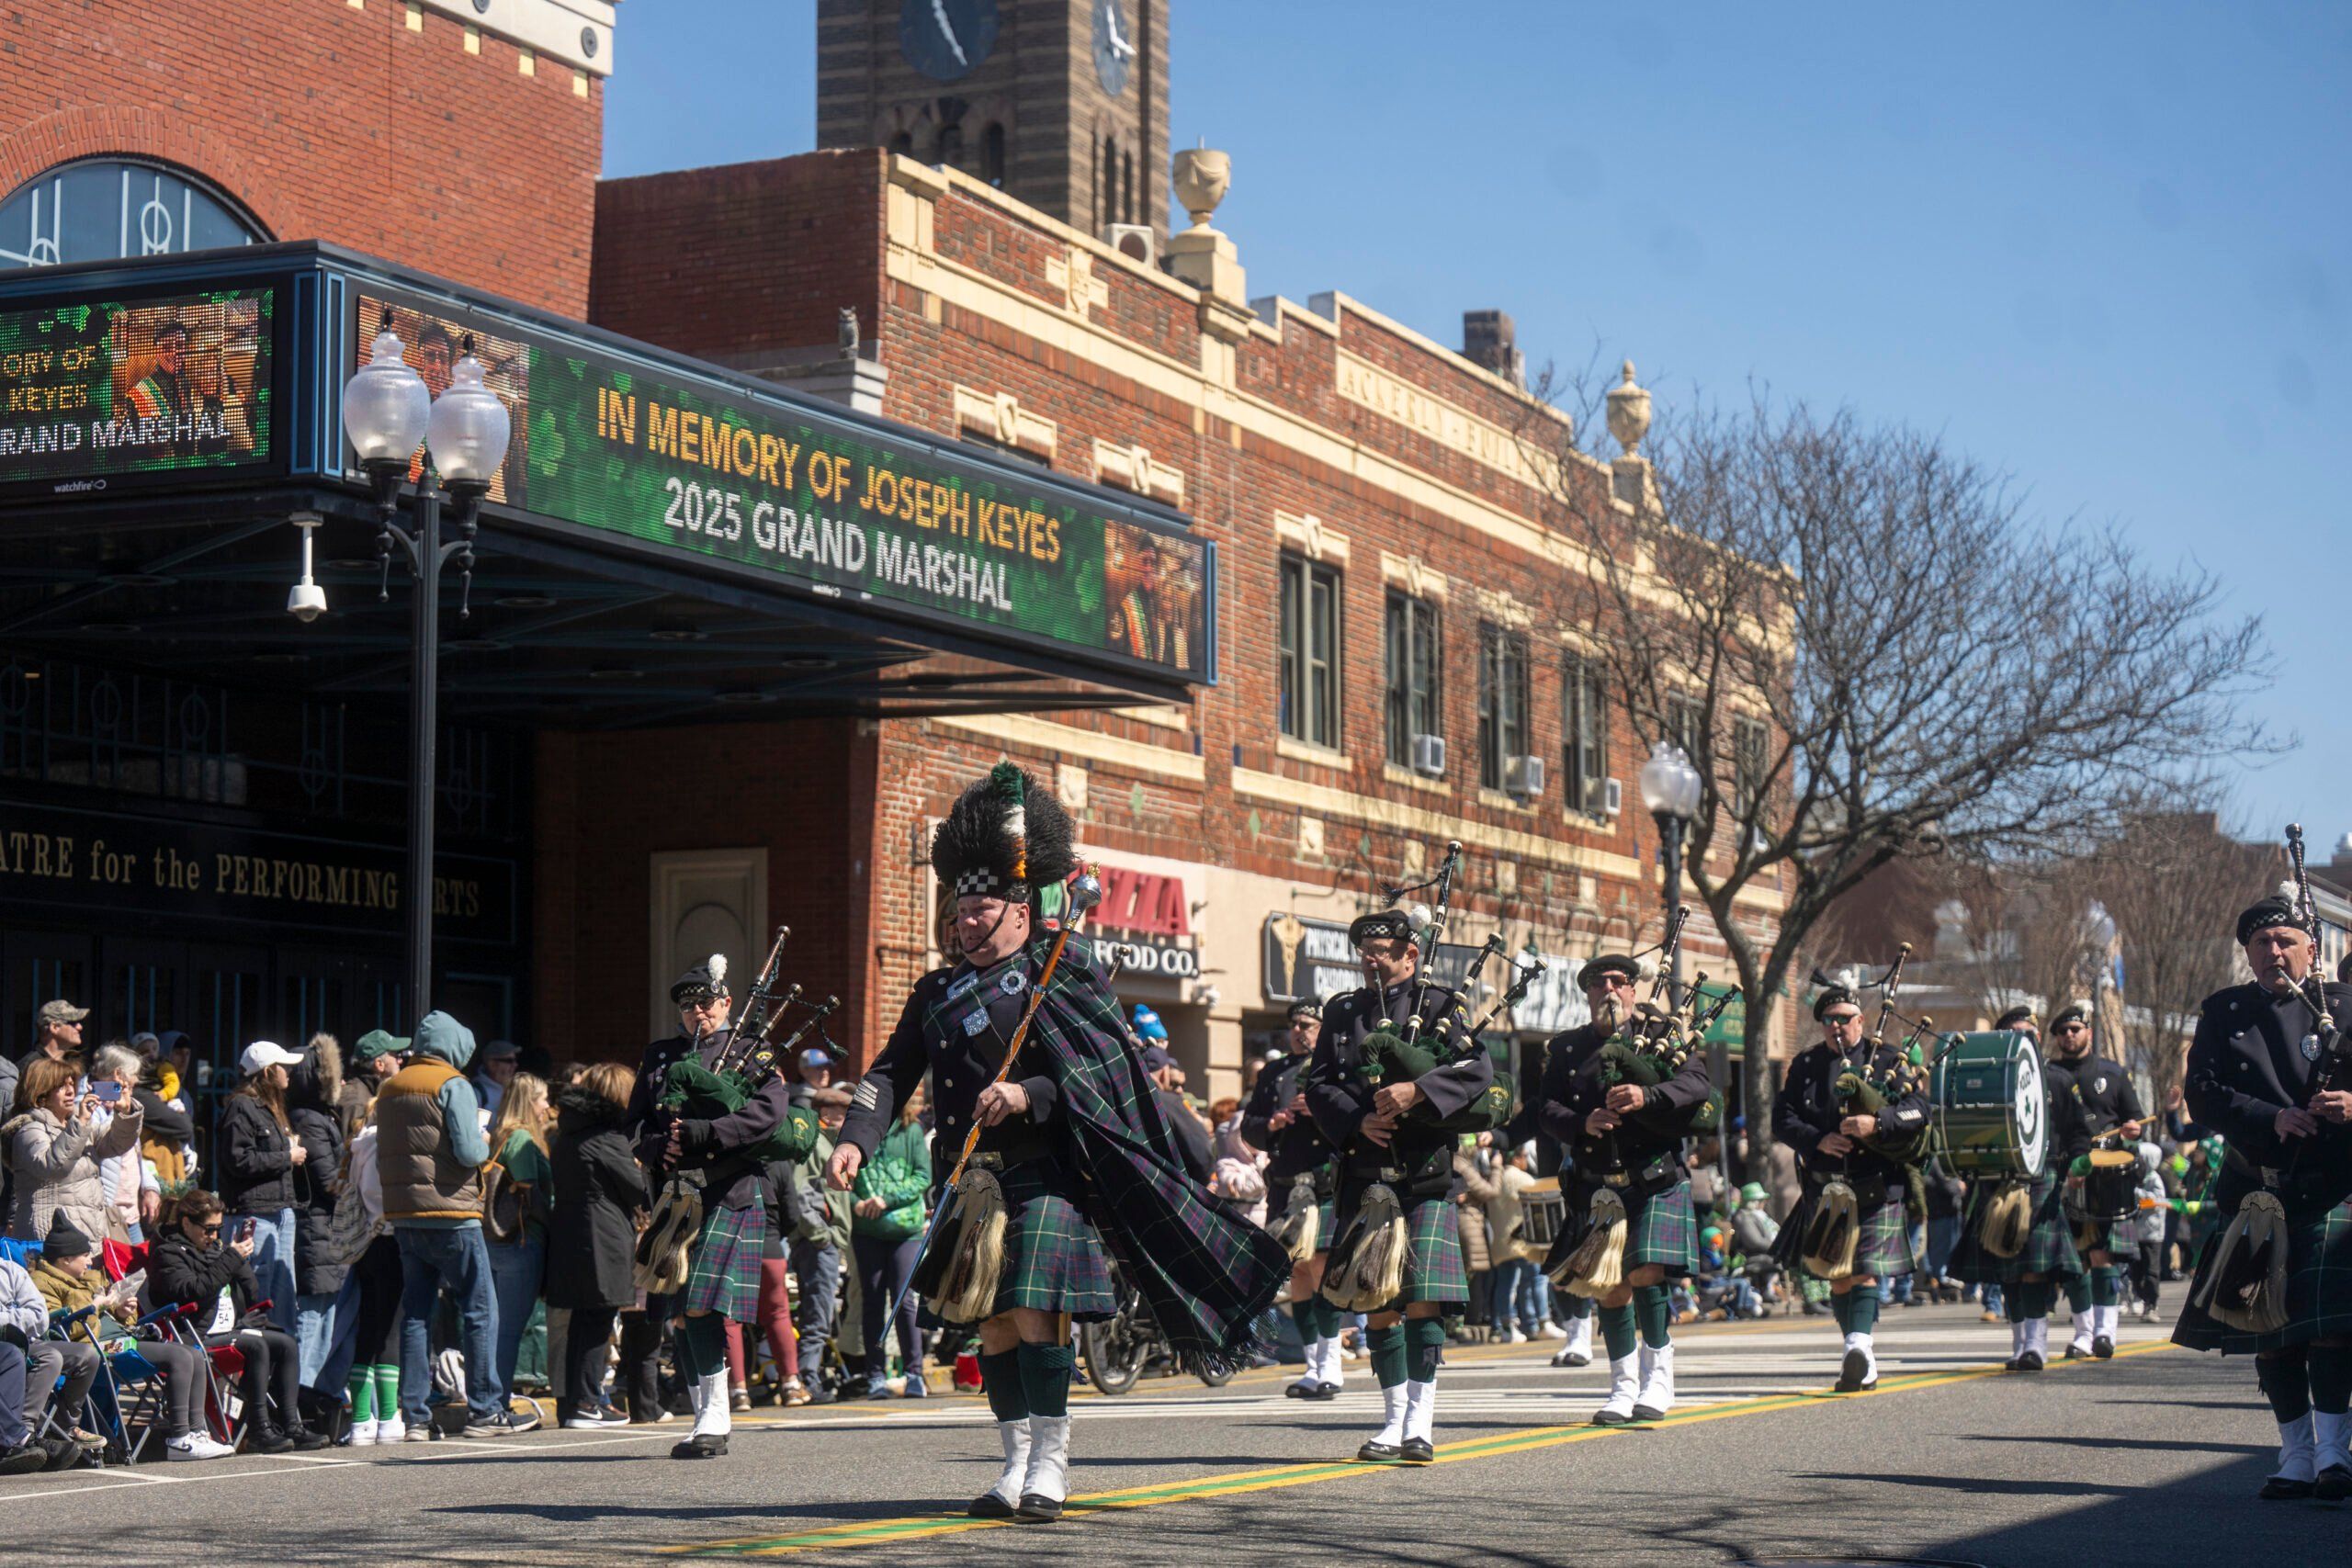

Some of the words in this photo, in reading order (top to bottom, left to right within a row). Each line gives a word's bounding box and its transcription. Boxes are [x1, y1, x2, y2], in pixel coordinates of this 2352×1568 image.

[4, 351, 54, 378] ORY
[62, 345, 96, 370] OF
[9, 384, 87, 412] KEYES
[92, 411, 231, 449] MARSHAL
[54, 480, 92, 493] watchfire
[598, 387, 636, 445] IN
[649, 401, 800, 491] MEMORY
[808, 450, 851, 503] OF
[859, 466, 970, 537] JOSEPH
[978, 499, 1060, 563] KEYES
[664, 477, 742, 541] 2025
[752, 501, 866, 573] GRAND
[876, 531, 1012, 612] MARSHAL
[89, 839, 137, 884] for
[153, 846, 201, 891] the
[215, 853, 399, 910] PERFORMING
[432, 875, 480, 919] RTS
[1160, 948, 1199, 977] CO.
